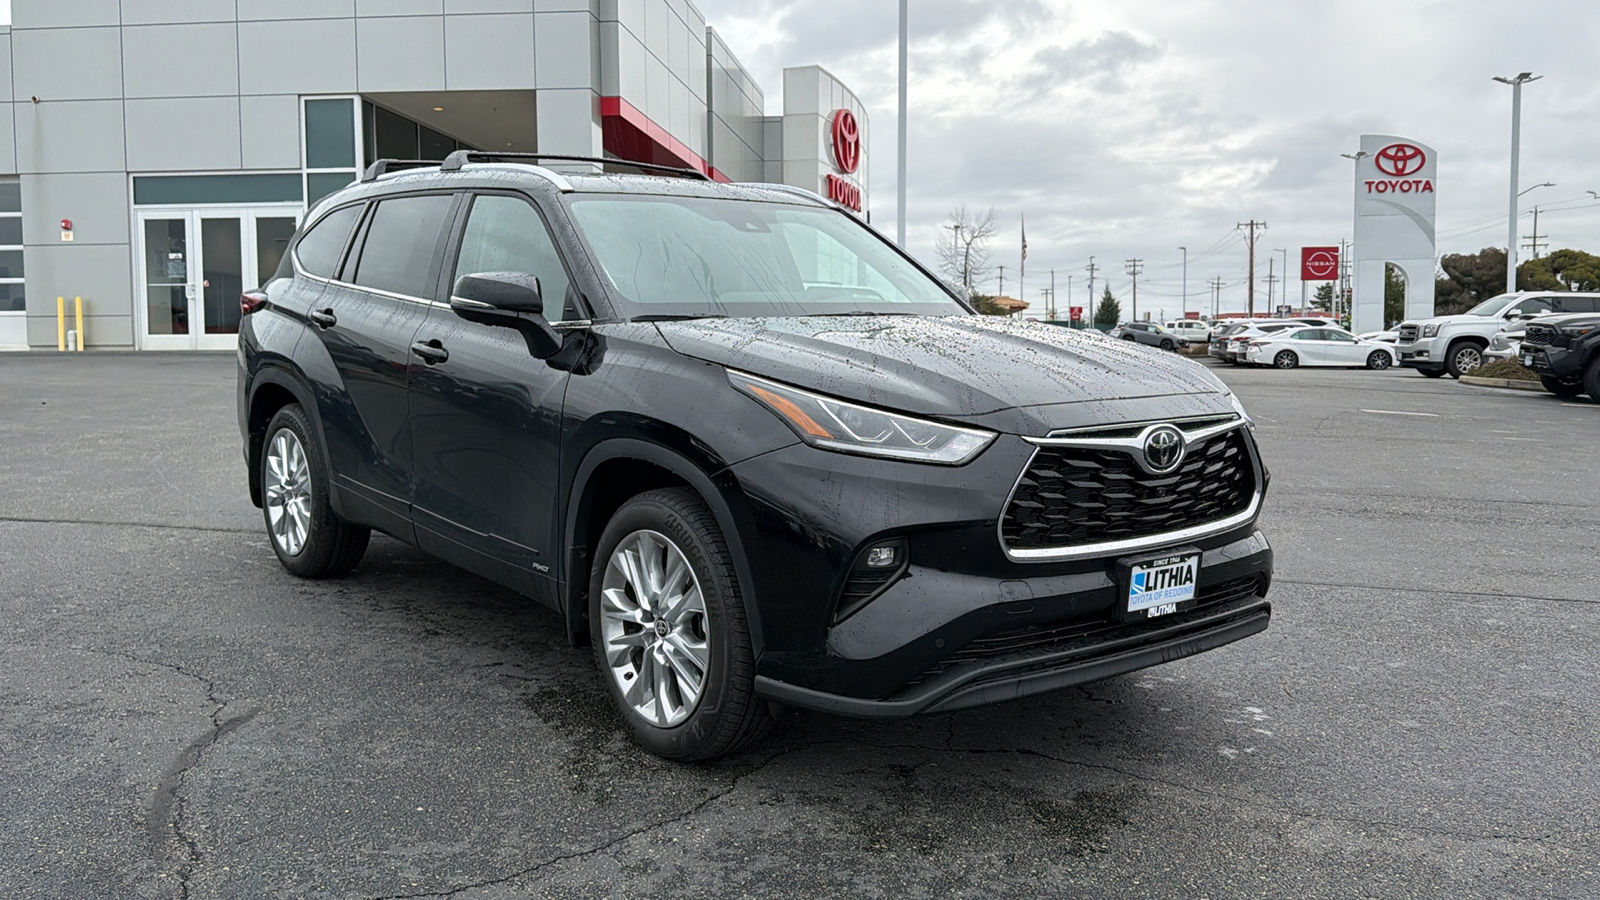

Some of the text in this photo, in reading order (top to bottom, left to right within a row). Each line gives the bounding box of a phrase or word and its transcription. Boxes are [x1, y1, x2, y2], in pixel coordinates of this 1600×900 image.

[826, 174, 861, 212] TOYOTA
[1364, 180, 1434, 194] TOYOTA
[664, 512, 722, 622] BRIDGESTONE
[1153, 558, 1169, 566] SINCE
[1145, 564, 1193, 592] LITHIA
[1130, 585, 1193, 606] TOYOTA OF REDDING
[1154, 602, 1177, 616] LITHIA
